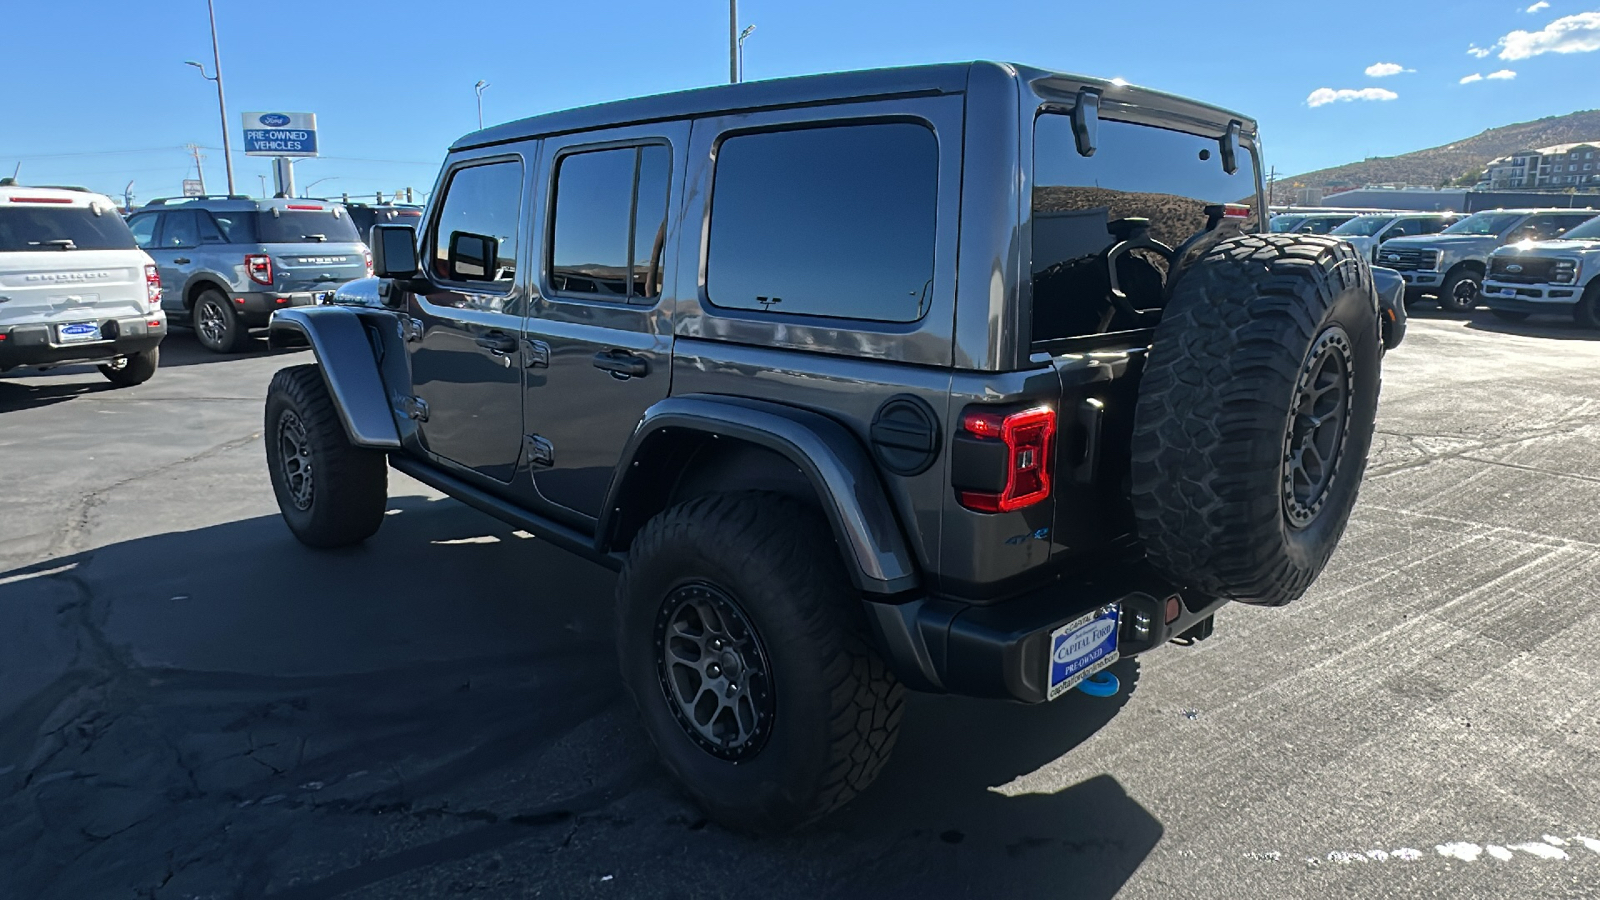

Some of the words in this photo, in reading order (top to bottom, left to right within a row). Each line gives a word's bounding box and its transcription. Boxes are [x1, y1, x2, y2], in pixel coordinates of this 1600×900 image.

[264, 115, 284, 124] Ford
[247, 131, 308, 141] PRE-OWNED
[253, 141, 302, 150] VEHICLES
[1058, 638, 1090, 660] CAPITAL
[1092, 624, 1111, 643] FORD
[1064, 647, 1103, 676] PRE-OWNED
